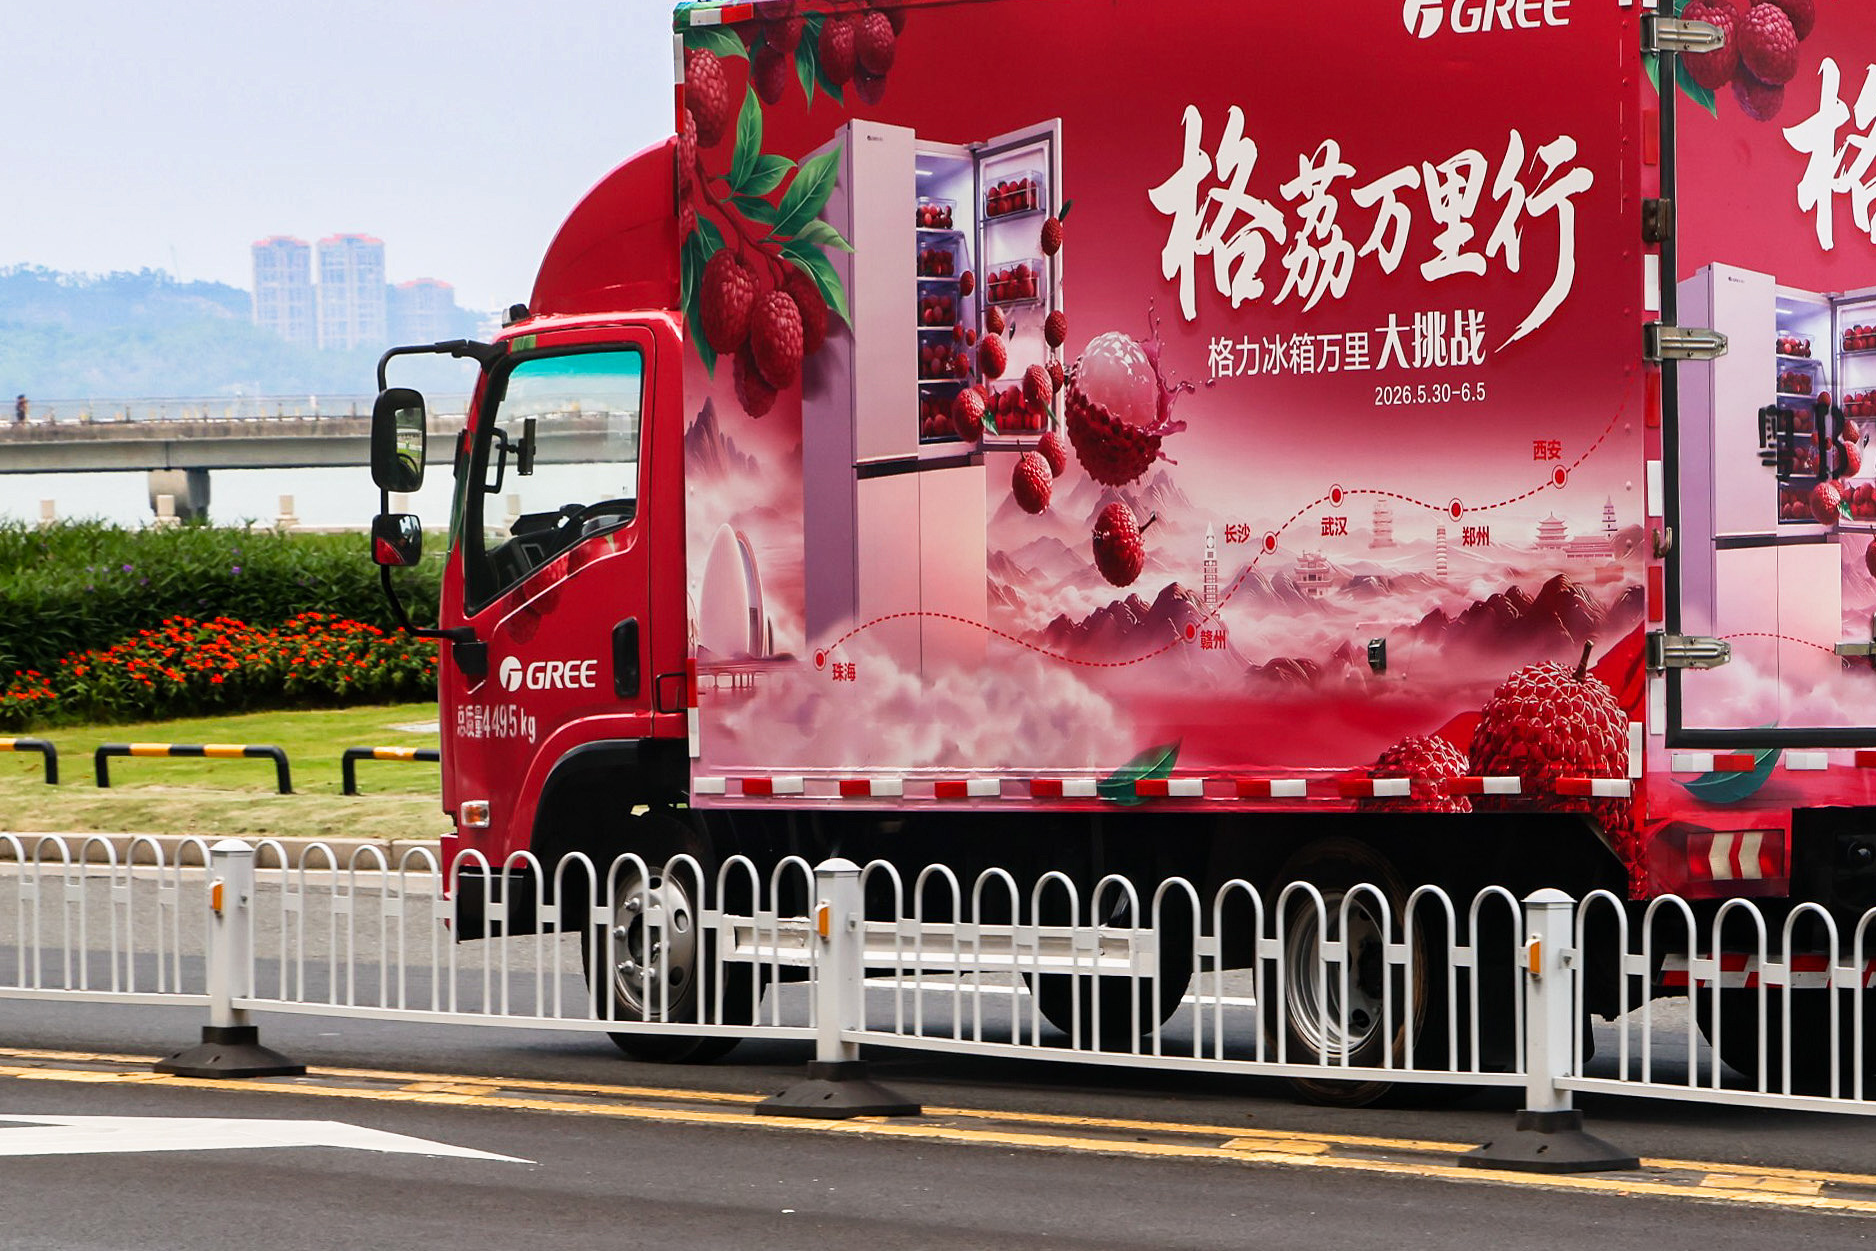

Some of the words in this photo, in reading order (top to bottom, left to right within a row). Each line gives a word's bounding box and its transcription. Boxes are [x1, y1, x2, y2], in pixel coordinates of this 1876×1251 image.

[1148, 104, 1595, 353] 格荔万里行
[1207, 309, 1487, 379] 格力冰箱万里大挑战
[1374, 381, 1487, 406] 2026.5.30-6.5
[1532, 439, 1562, 462] 西安
[1224, 523, 1251, 544] 长沙
[1320, 515, 1348, 538] 武汉
[1461, 525, 1491, 548] 郑州
[1200, 629, 1226, 650] 赣州
[525, 659, 598, 690] GREE
[832, 662, 856, 682] 珠海
